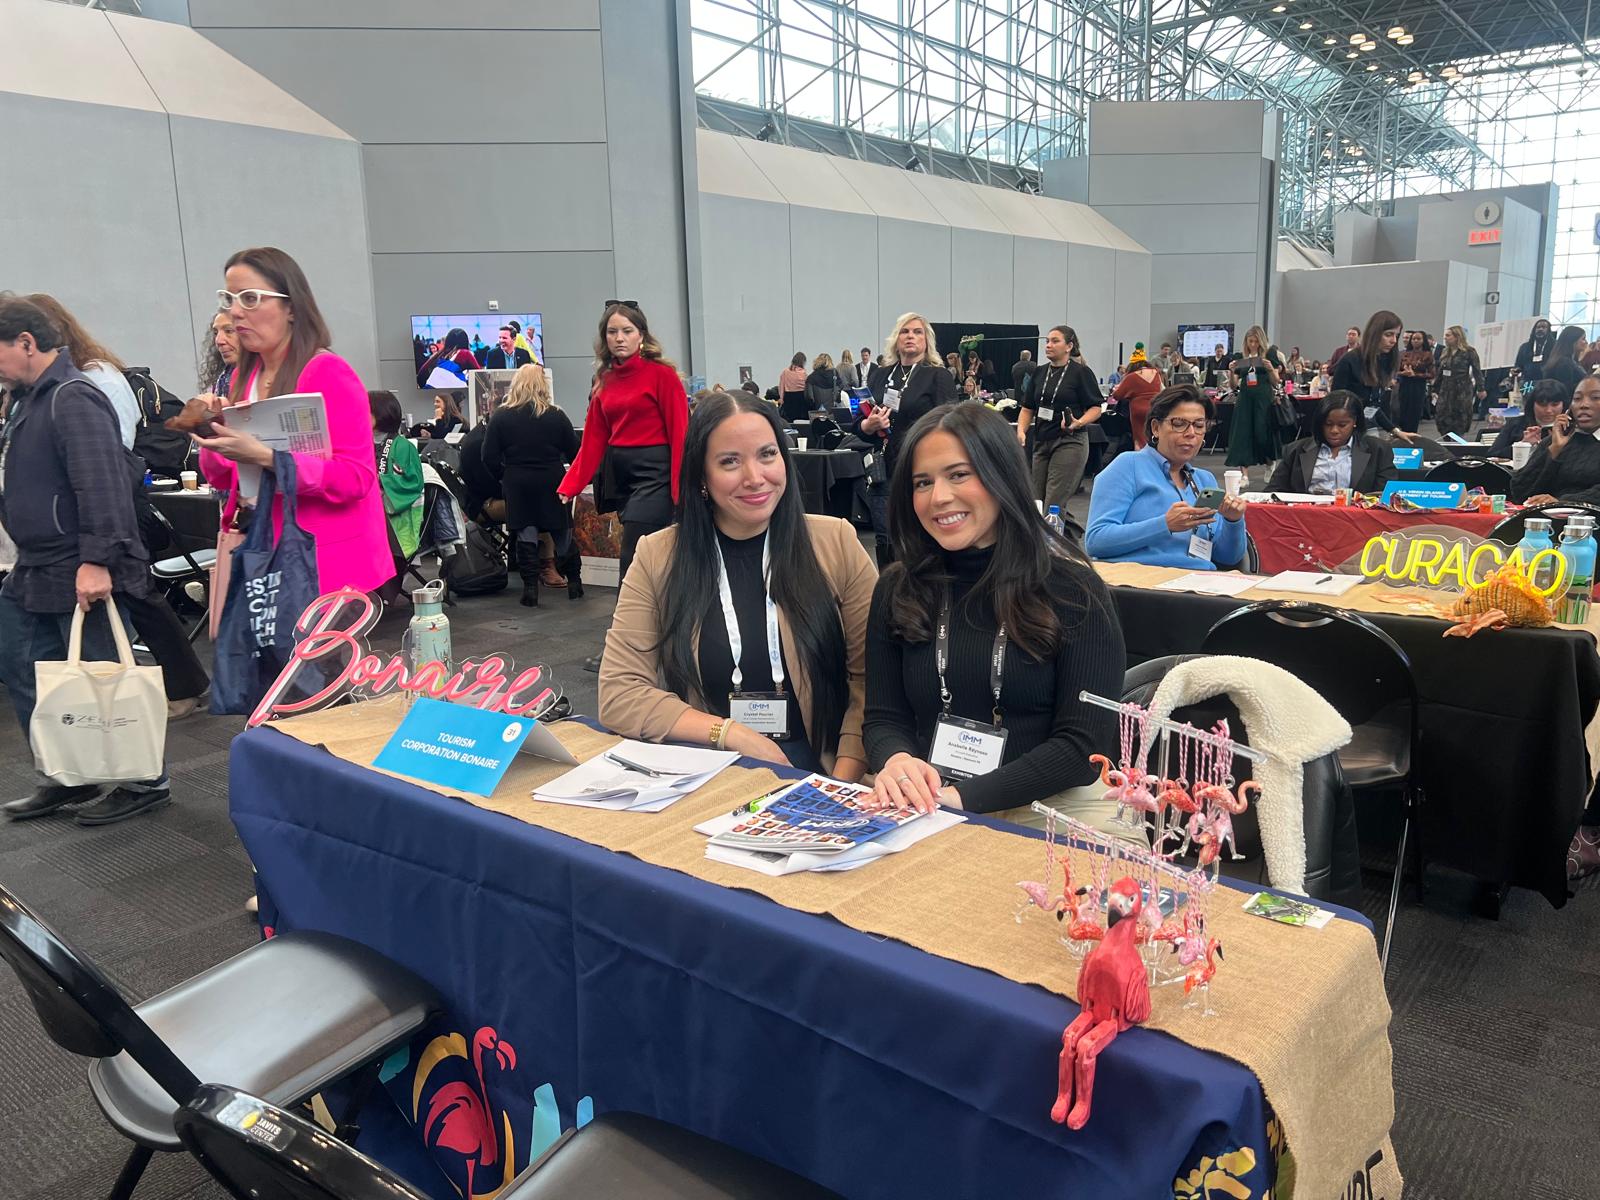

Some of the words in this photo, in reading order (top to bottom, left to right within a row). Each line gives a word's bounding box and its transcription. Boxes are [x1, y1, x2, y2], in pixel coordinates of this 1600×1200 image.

[1470, 229, 1499, 243] EXIT
[381, 438, 393, 459] EAST
[437, 732, 476, 749] TOURISM
[506, 728, 517, 737] 31
[961, 733, 983, 745] IMM
[401, 738, 460, 761] CORPORATION
[459, 752, 500, 770] BONAIRE
[249, 1126, 277, 1143] CENTER
[256, 1117, 282, 1136] JAVITS
